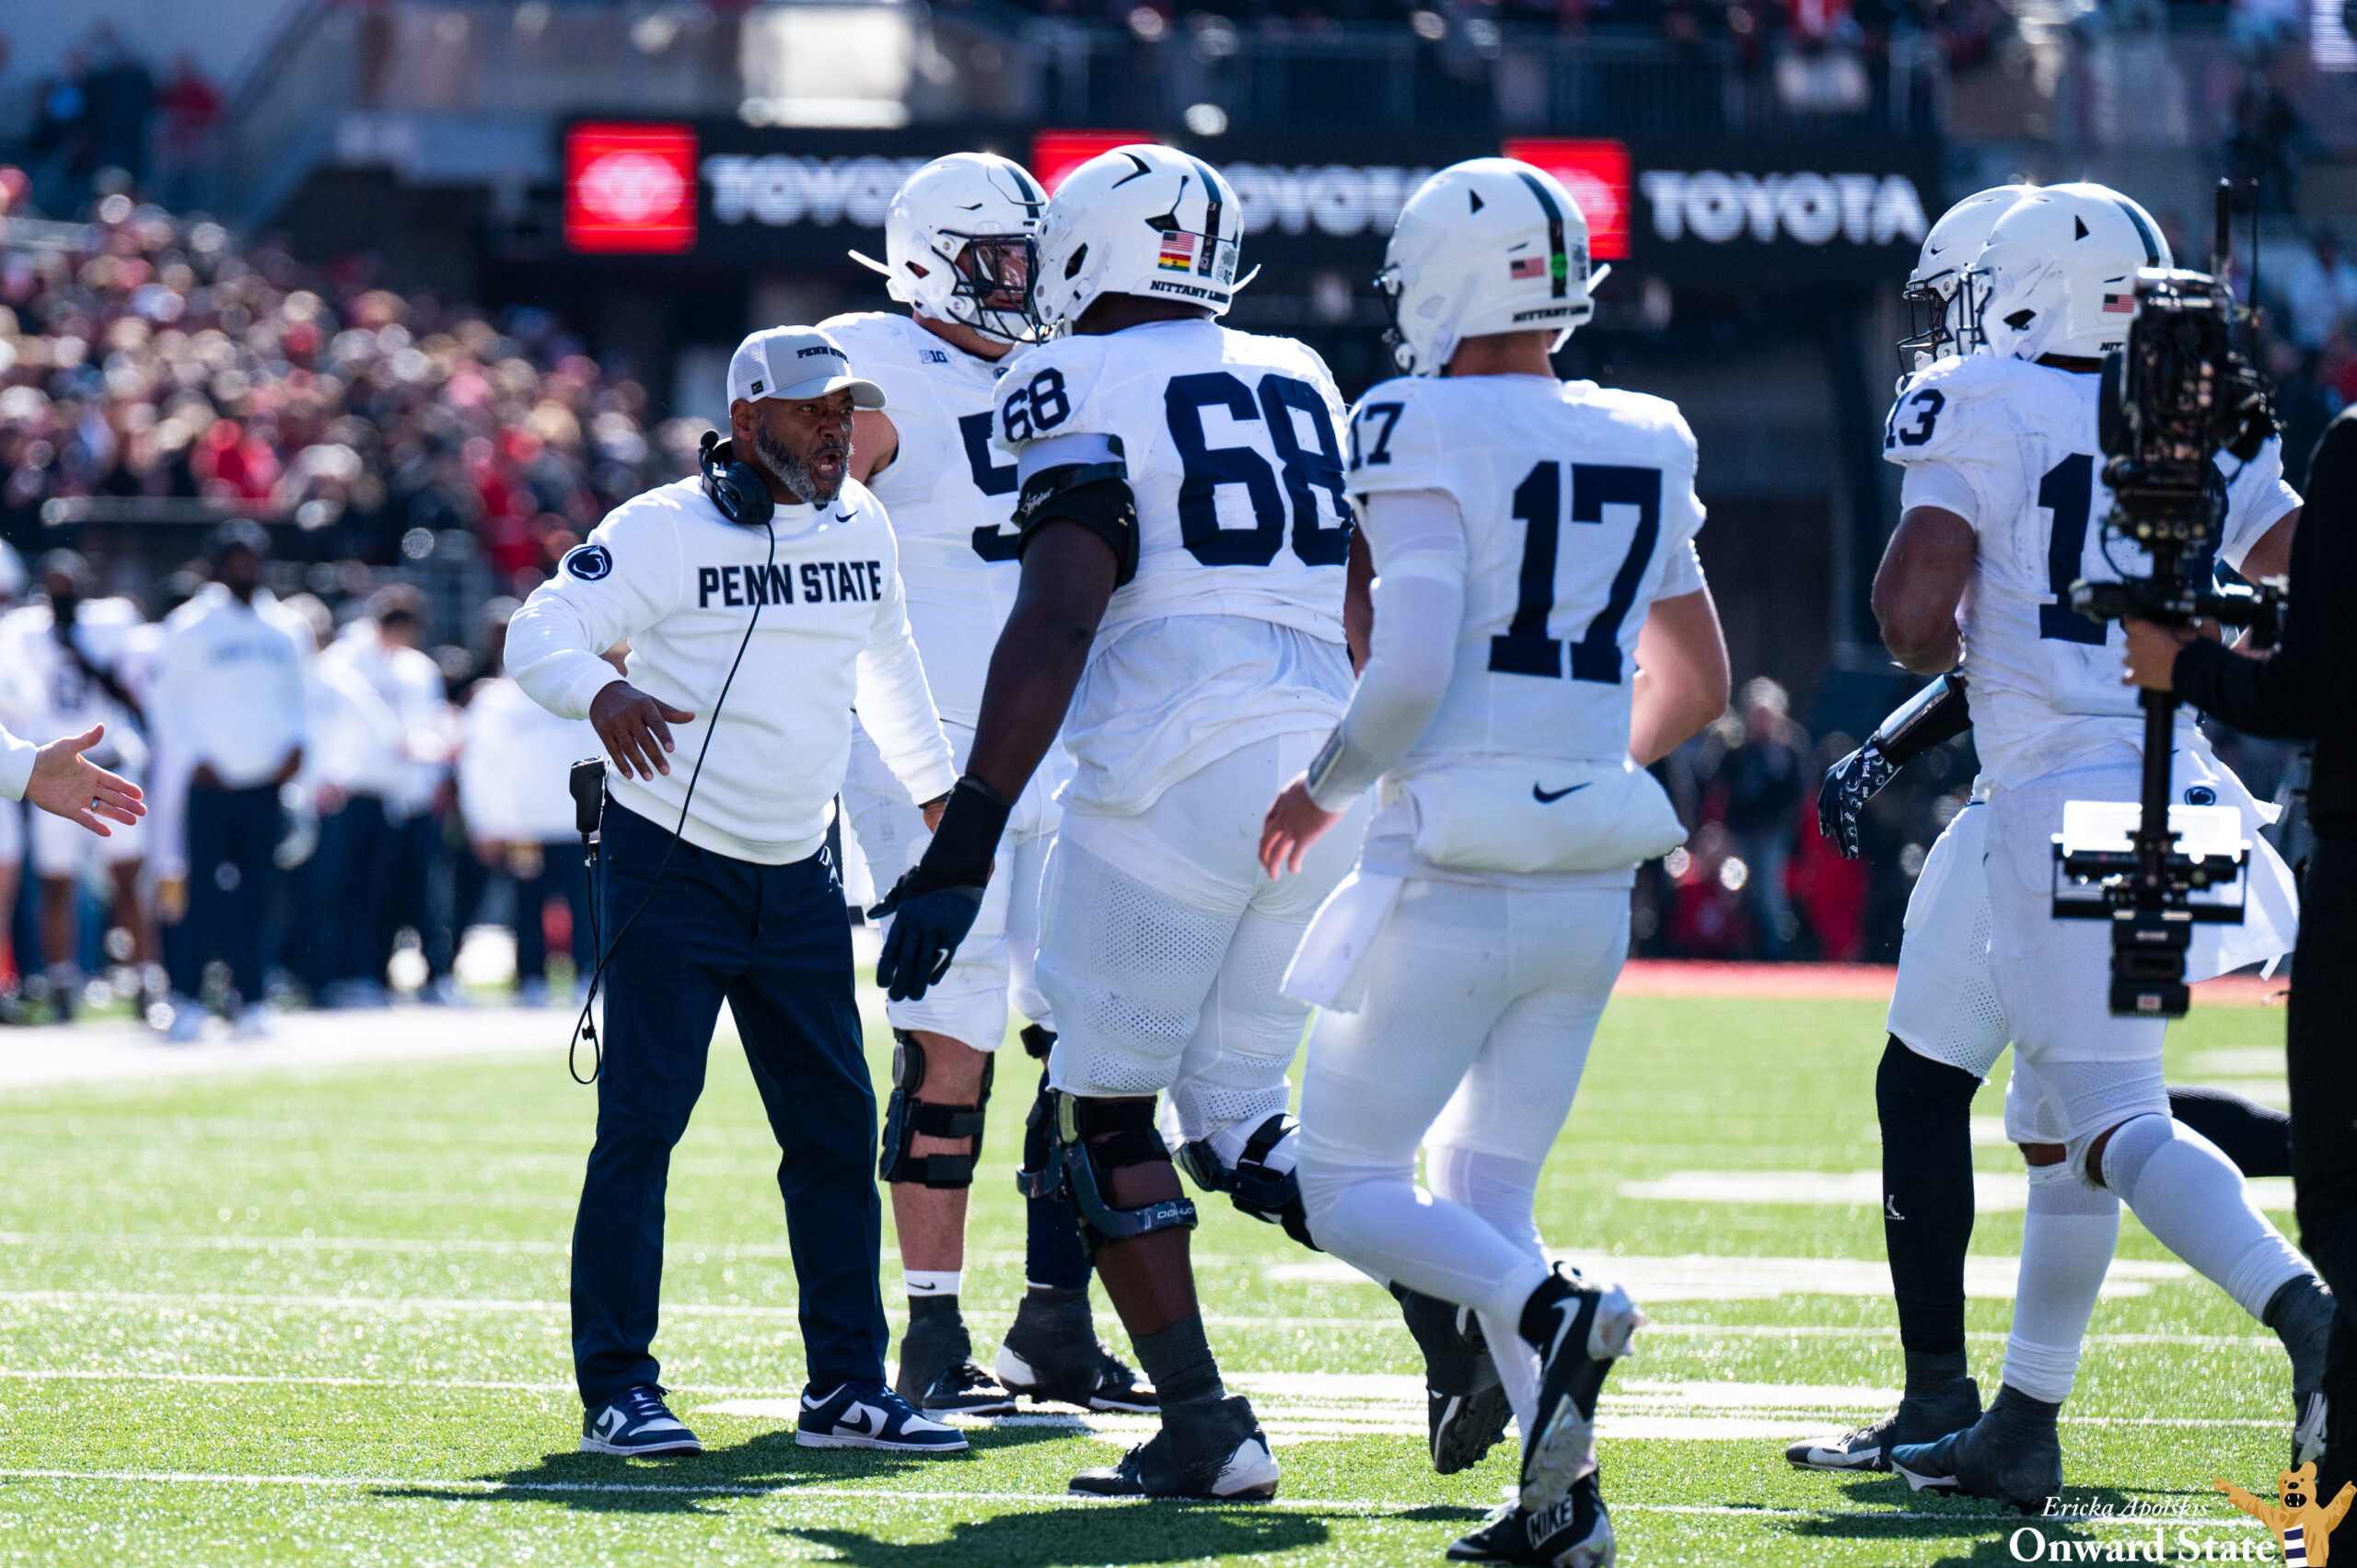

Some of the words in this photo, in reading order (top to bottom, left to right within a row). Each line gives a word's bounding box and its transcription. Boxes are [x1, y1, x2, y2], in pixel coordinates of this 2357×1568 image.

[701, 153, 930, 228] TOYO
[1215, 161, 1433, 237] OYOT
[1639, 169, 1932, 246] TOYOTA
[1150, 280, 1208, 299] NITTANY
[796, 346, 829, 358] PENN
[1002, 366, 1071, 443] 68
[1349, 402, 1405, 471] 17
[1886, 389, 1946, 449] 13
[1164, 371, 1353, 567] 68
[697, 563, 795, 610] PENN
[799, 560, 882, 604] STATE
[1487, 459, 1662, 685] 17
[1527, 1493, 1573, 1551] NIKE
